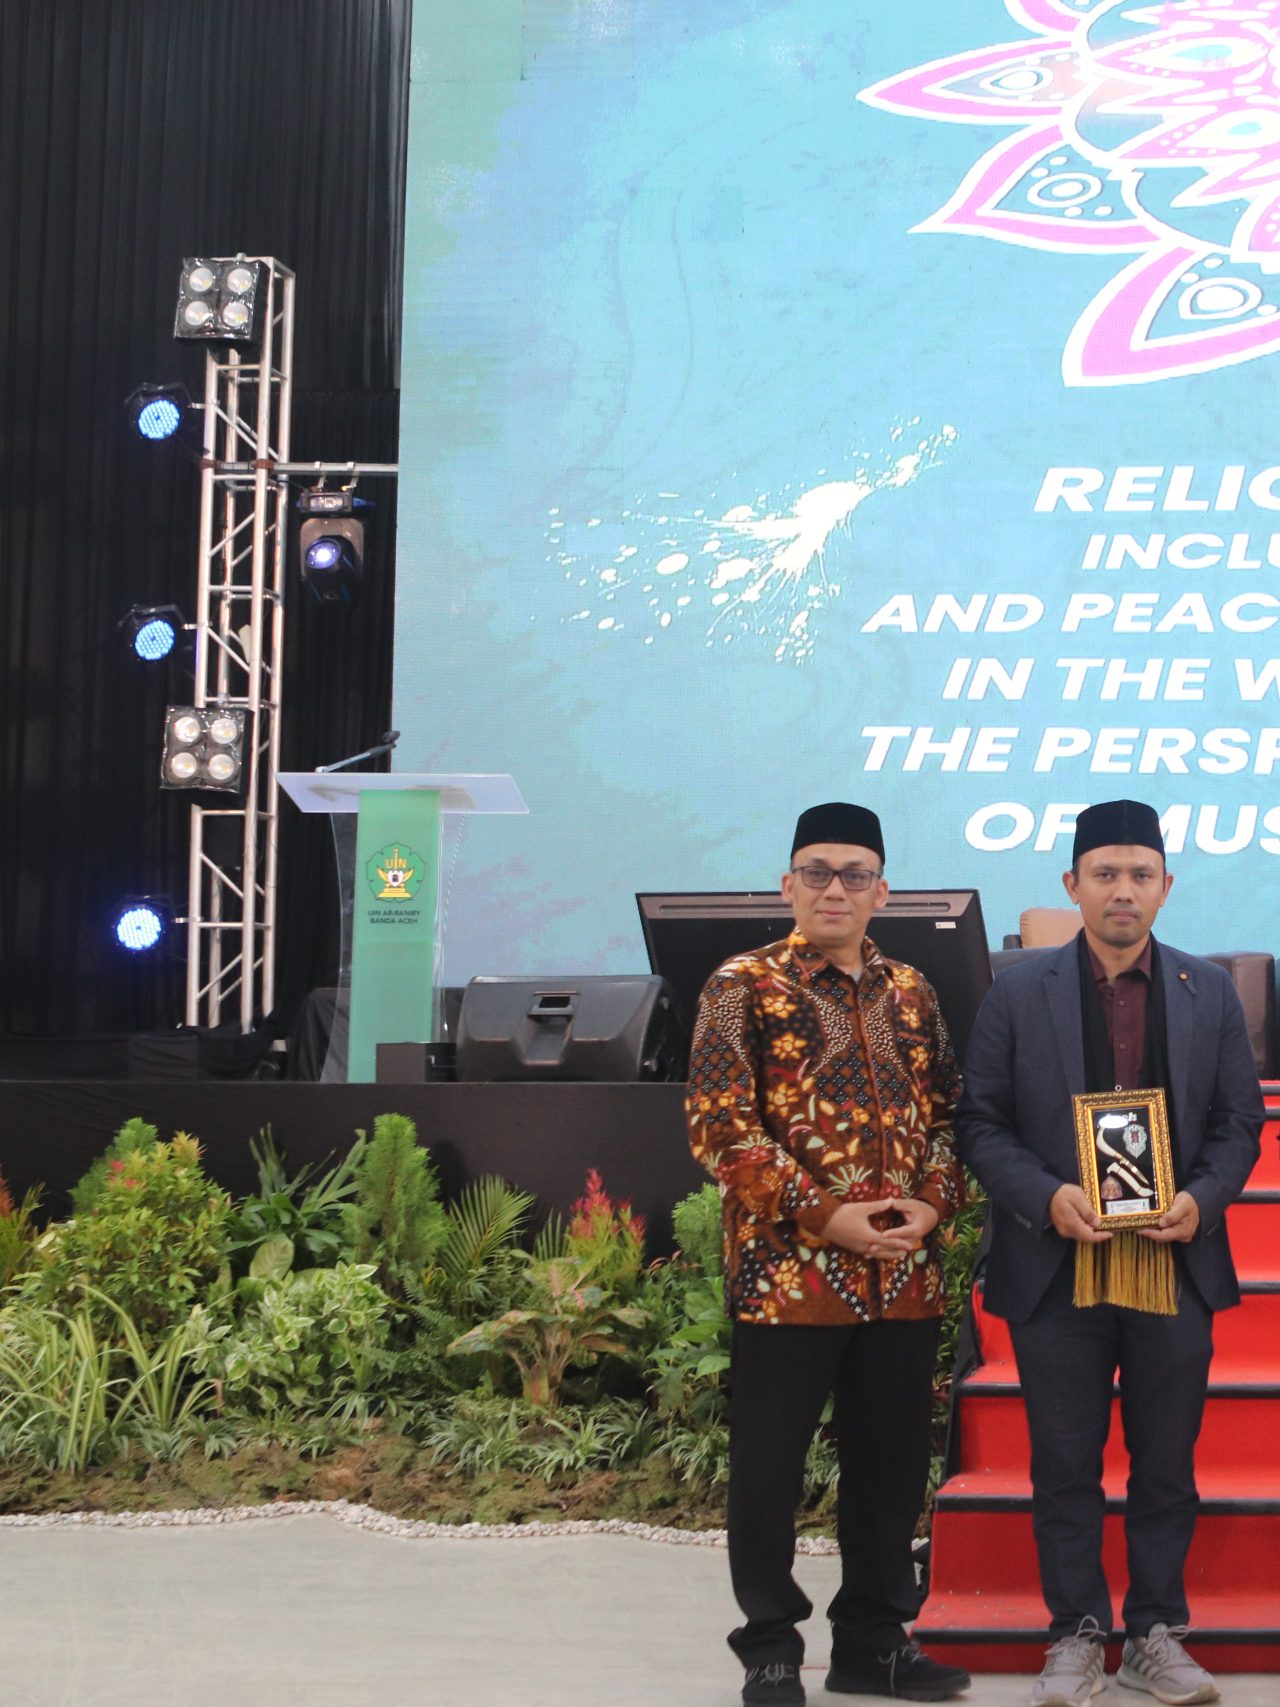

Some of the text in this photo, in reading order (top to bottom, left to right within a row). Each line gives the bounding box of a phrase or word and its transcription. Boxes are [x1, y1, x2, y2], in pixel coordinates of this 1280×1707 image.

[861, 592, 1045, 634] AND
[942, 656, 1035, 701] IN
[1055, 657, 1212, 701] THE
[860, 725, 1020, 774] THE
